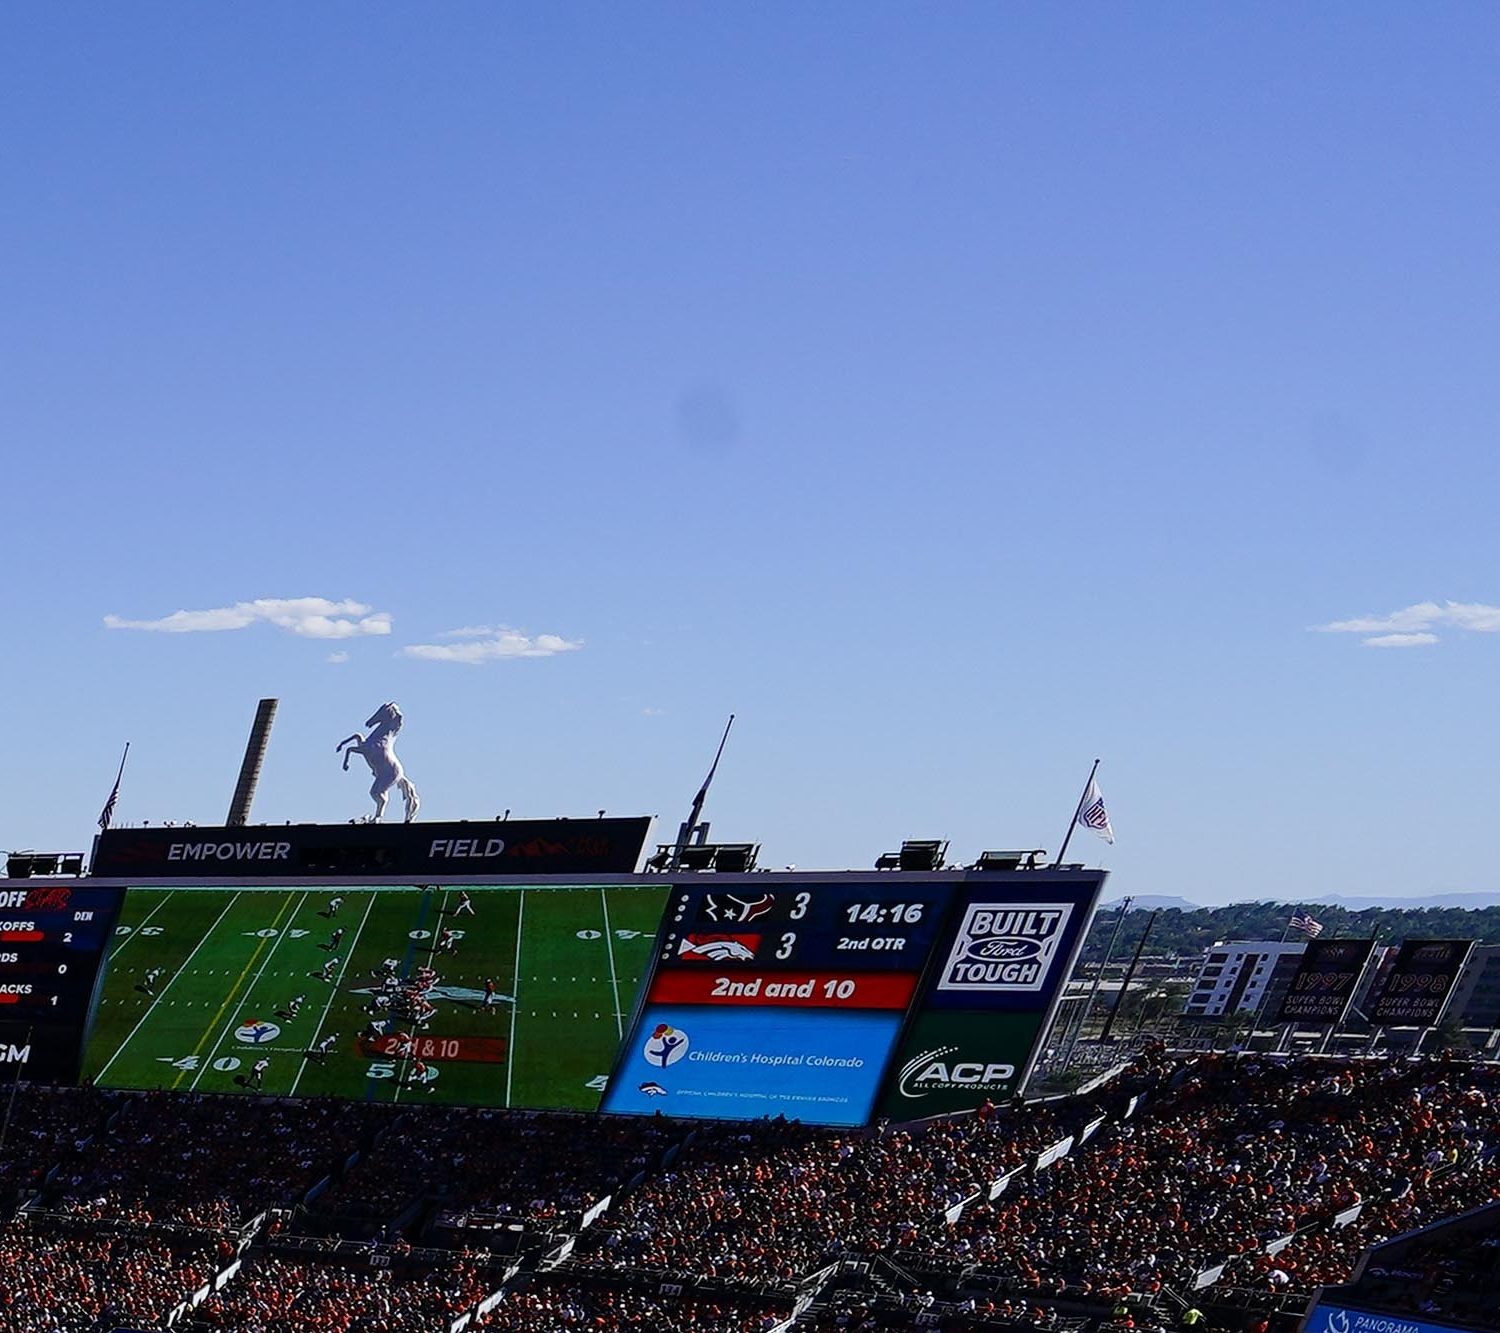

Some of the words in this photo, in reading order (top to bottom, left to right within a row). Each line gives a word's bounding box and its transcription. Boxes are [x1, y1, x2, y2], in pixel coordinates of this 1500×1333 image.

[167, 841, 291, 862] EMPOWER
[429, 838, 505, 860] FIELD
[789, 892, 811, 920] 3
[847, 903, 922, 924] 14:16
[74, 911, 93, 922] DEN
[969, 910, 1060, 936] BUILT
[63, 932, 72, 943] 2
[776, 932, 796, 960] 3
[837, 938, 866, 951] 2nd
[871, 938, 905, 951] QTR
[981, 941, 1032, 958] Ford
[58, 964, 67, 975] 0
[955, 962, 1040, 983] TOUGH
[711, 977, 760, 997] 2nd
[765, 979, 815, 998] and
[824, 980, 855, 999] 10
[1295, 972, 1354, 991] 1997
[1390, 973, 1450, 993] 1998
[1286, 995, 1316, 1005] SUPER
[1319, 995, 1345, 1005] BOWL
[1379, 997, 1409, 1007] SUPER
[1412, 997, 1439, 1008] BOWL
[1284, 1005, 1341, 1016] CHAMPIONS
[1376, 1006, 1435, 1018] CHAMPIONS
[440, 1039, 459, 1058] 10
[688, 1050, 748, 1064] Children's
[750, 1052, 803, 1067] Hospital
[806, 1054, 864, 1068] Colorado
[914, 1062, 1015, 1083] ACP
[933, 1082, 956, 1090] COPY
[957, 1083, 1009, 1091] PRODUCTS
